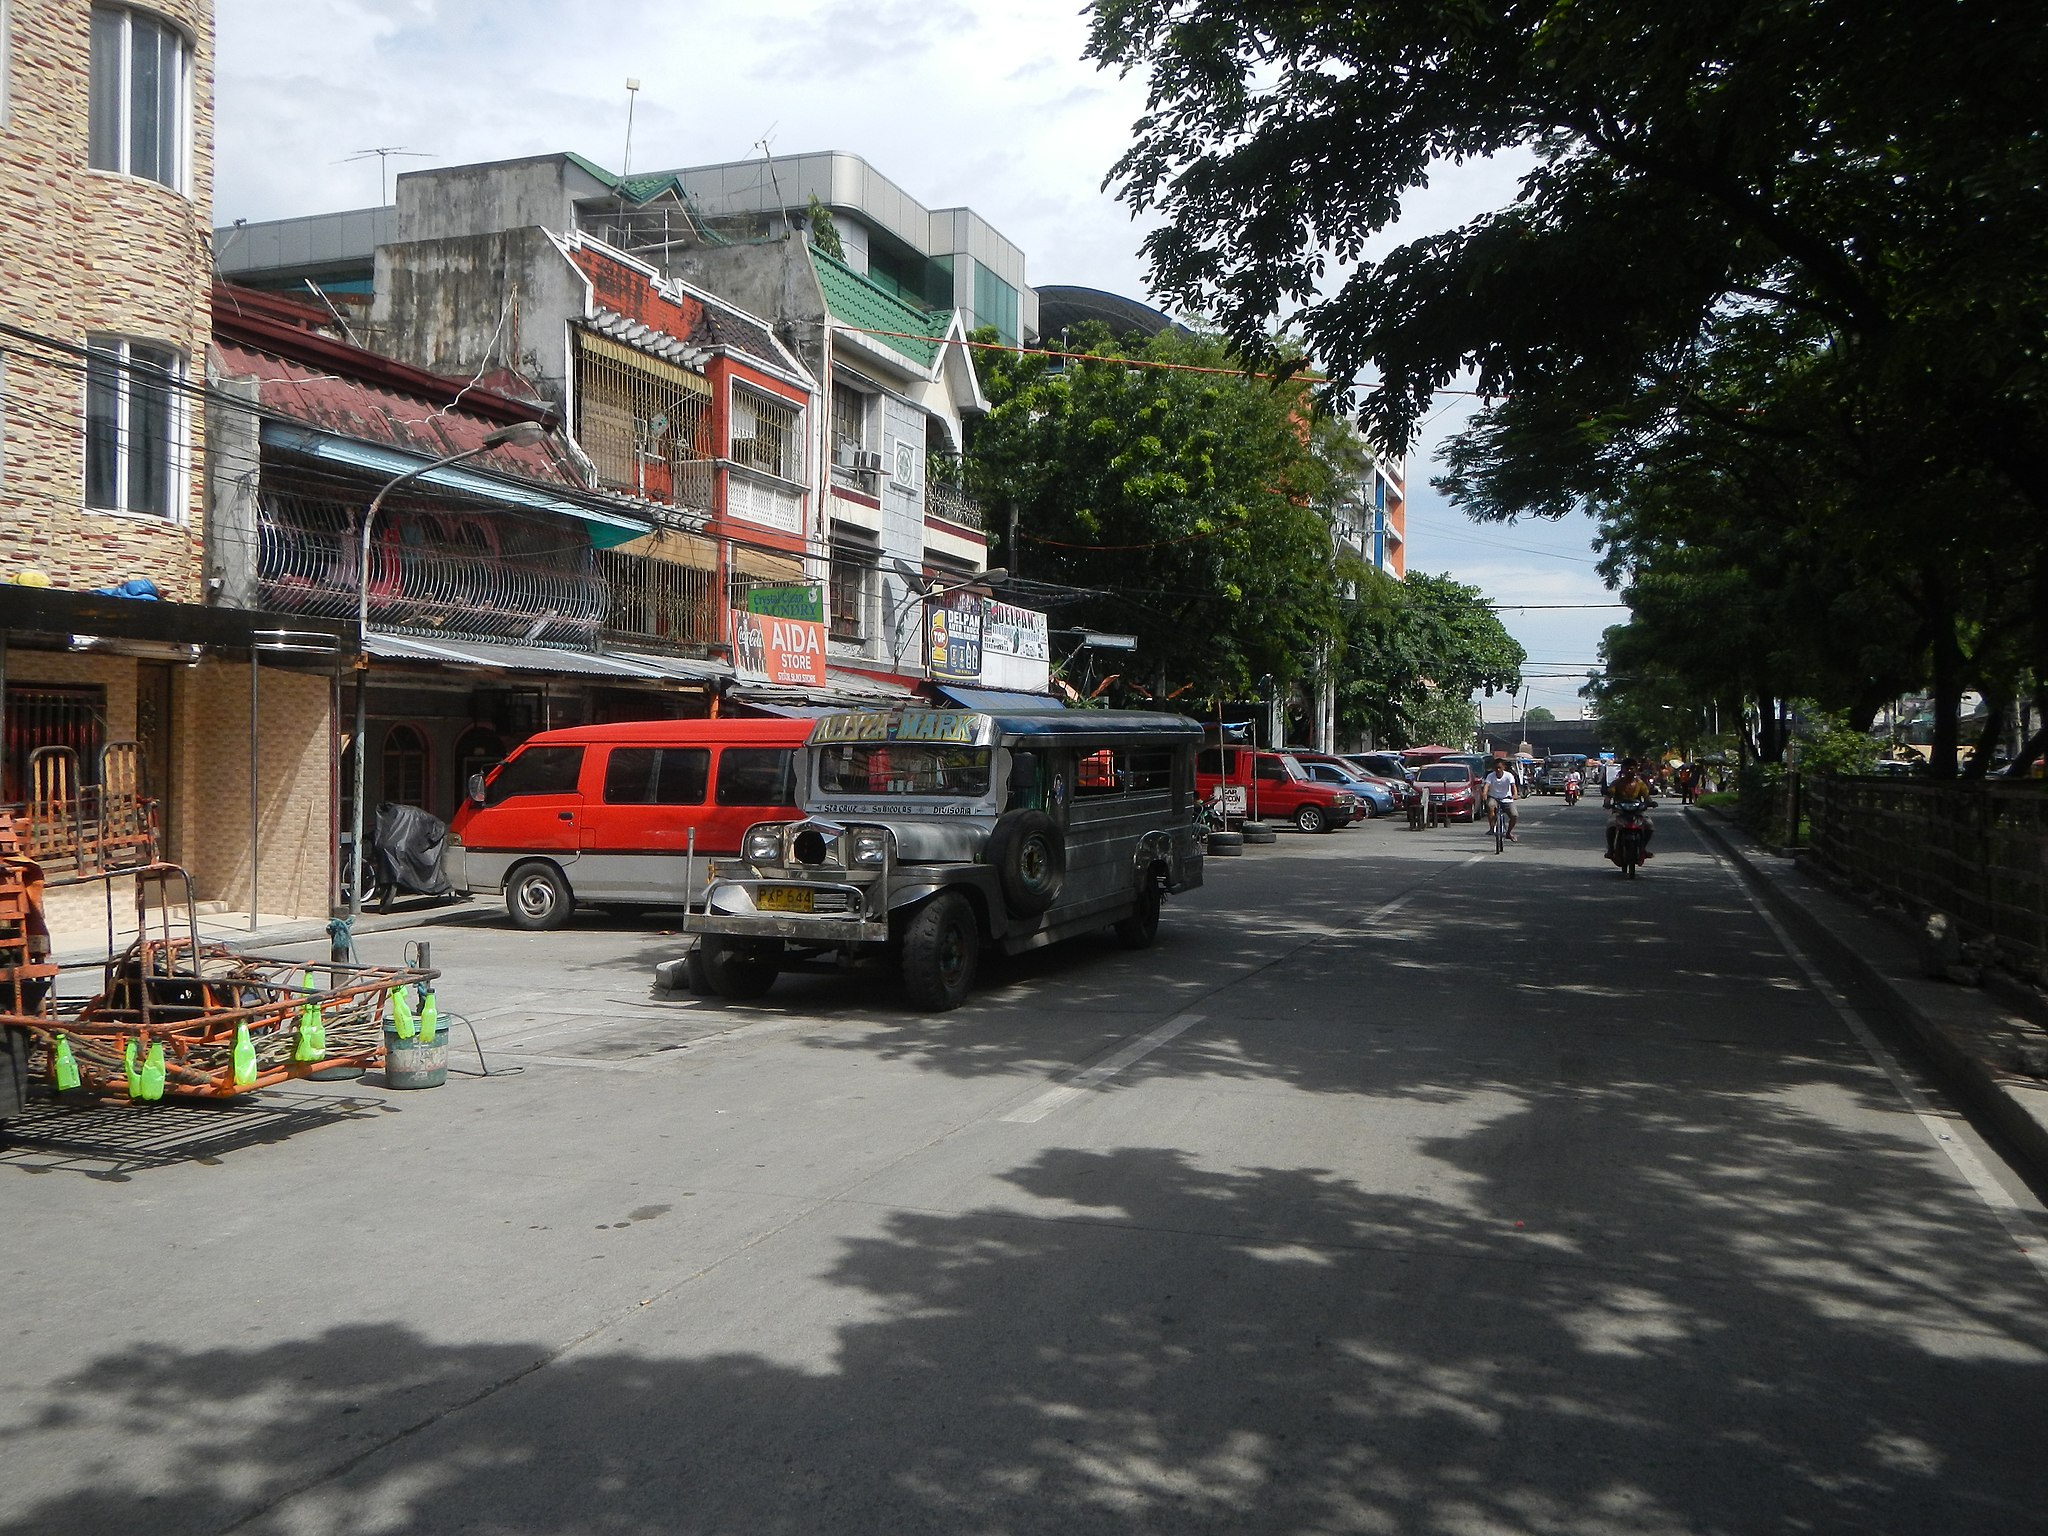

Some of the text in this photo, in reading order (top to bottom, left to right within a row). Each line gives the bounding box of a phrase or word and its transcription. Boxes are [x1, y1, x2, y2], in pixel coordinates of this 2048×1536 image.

[754, 591, 780, 606] Crystal
[754, 603, 816, 616] LAUNDRY
[948, 609, 980, 628] DELPAN
[998, 605, 1034, 630] DELPAN
[772, 622, 820, 655] AIDA
[933, 631, 946, 643] TOP
[781, 653, 811, 670] STORE
[897, 713, 976, 742] MARK
